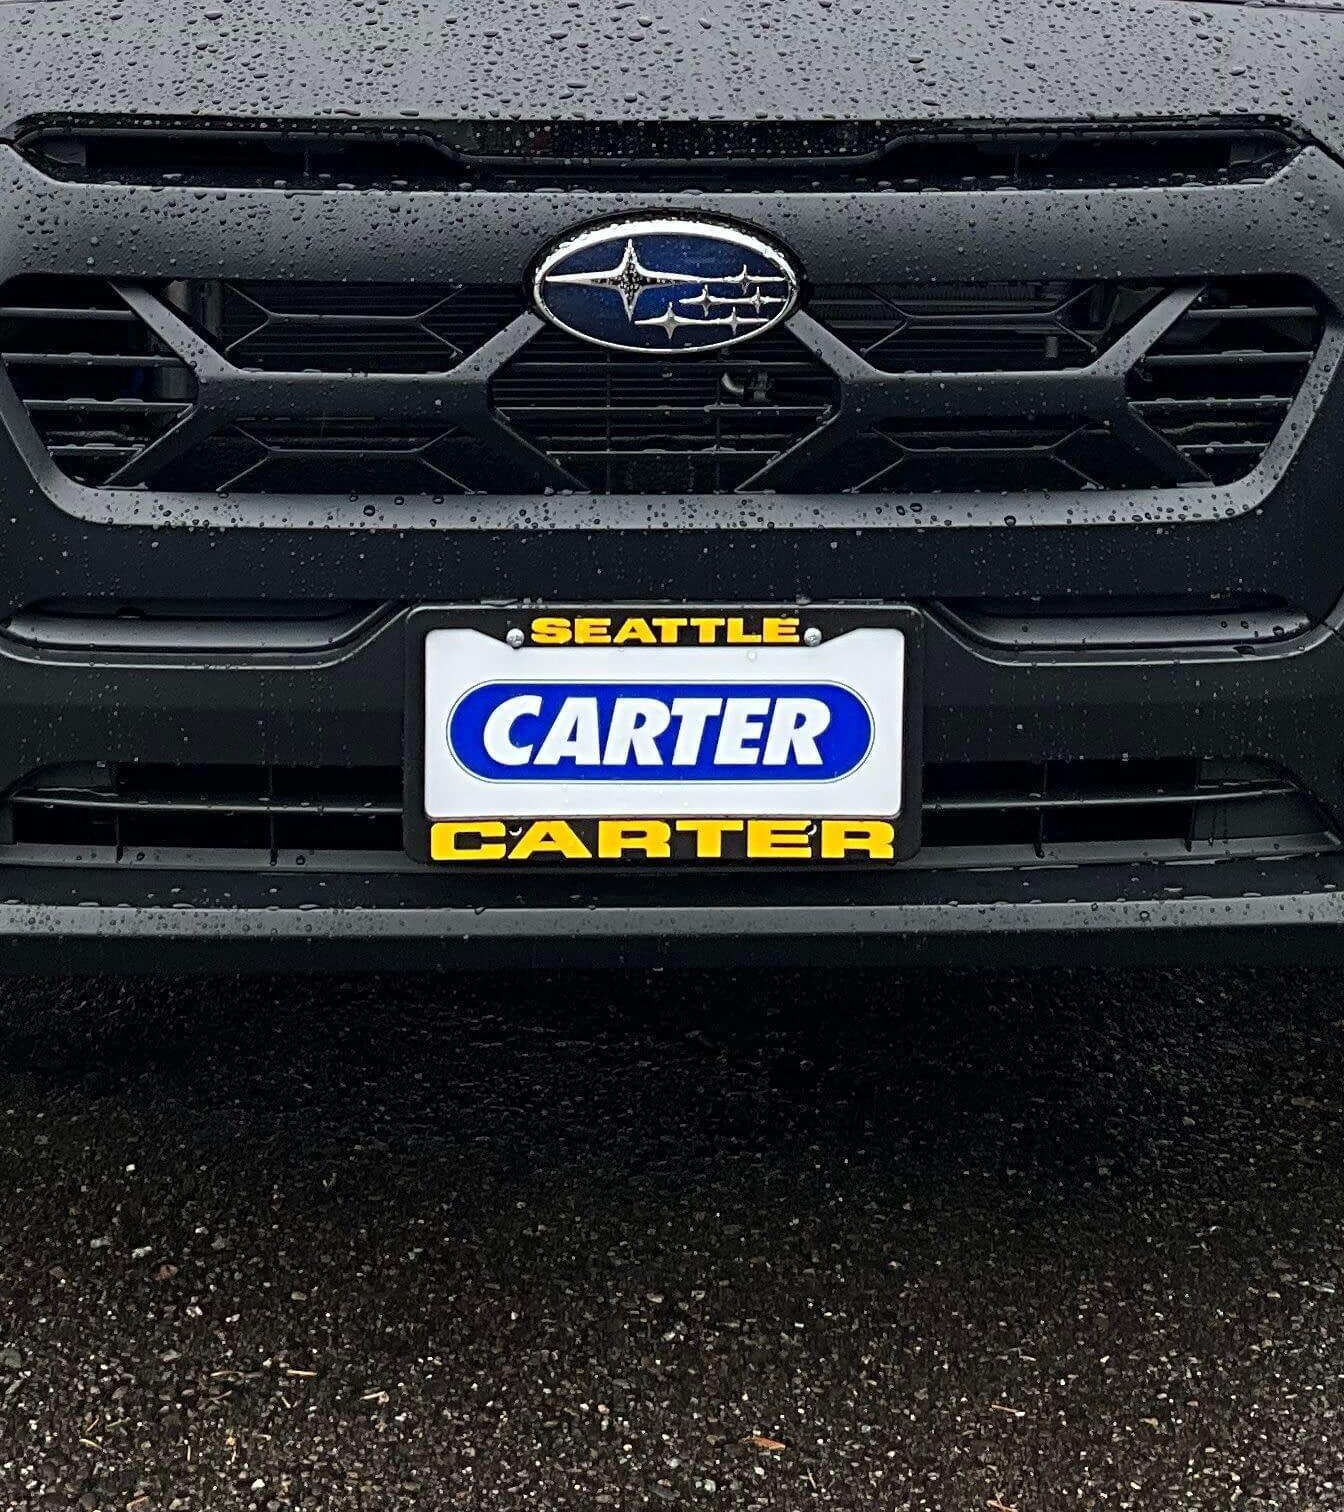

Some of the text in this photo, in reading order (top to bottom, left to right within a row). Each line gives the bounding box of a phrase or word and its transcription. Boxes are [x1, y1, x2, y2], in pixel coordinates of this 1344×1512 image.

[530, 617, 800, 645] SEATTLE
[482, 695, 831, 766] CARTER
[429, 820, 895, 860] CARTER
